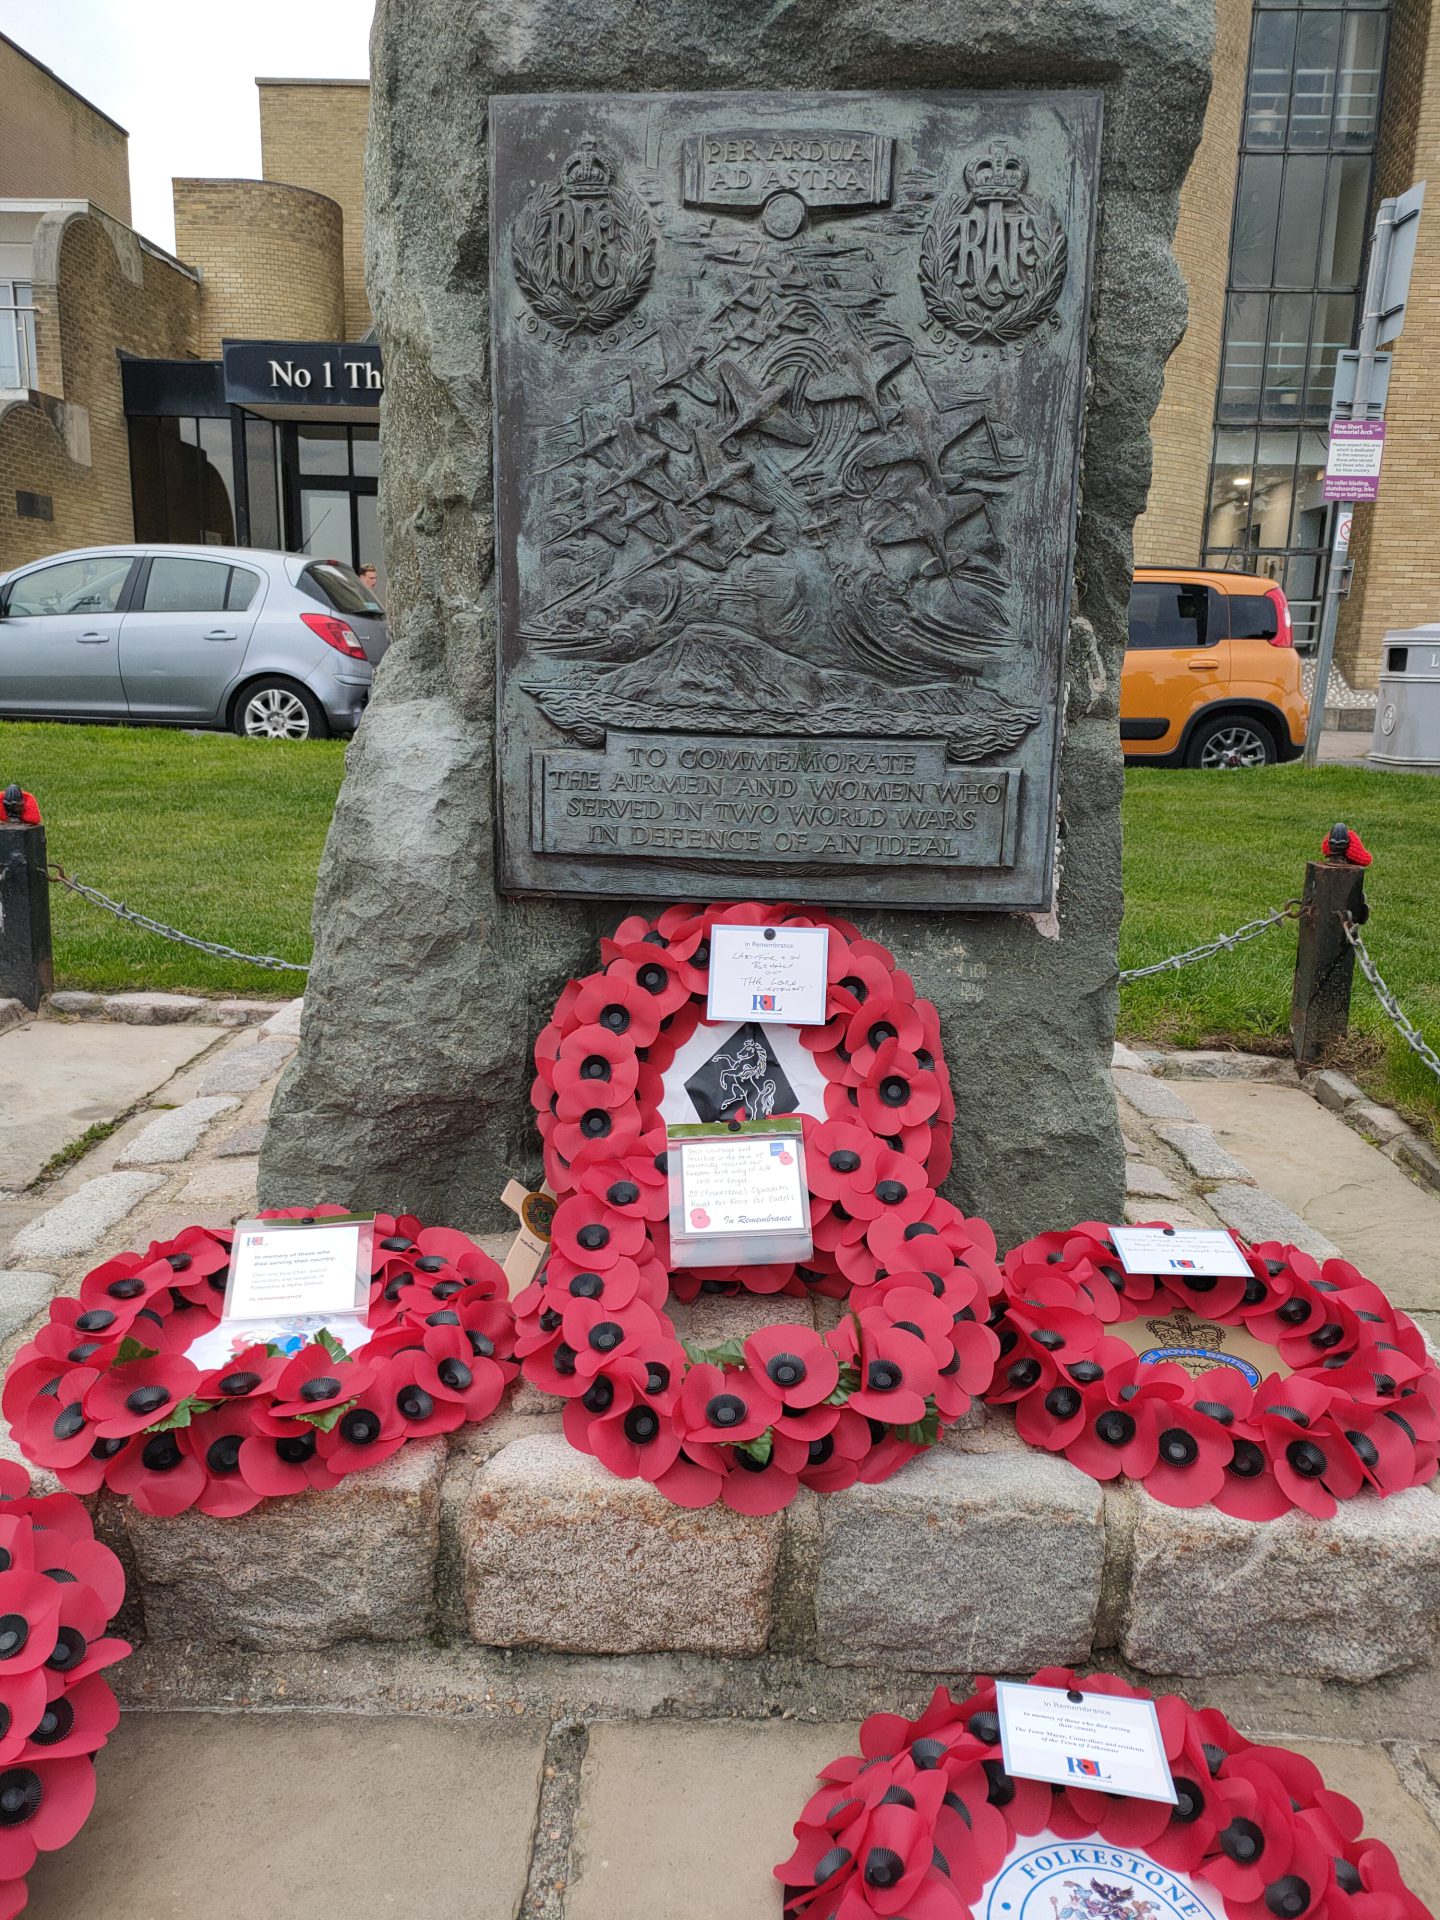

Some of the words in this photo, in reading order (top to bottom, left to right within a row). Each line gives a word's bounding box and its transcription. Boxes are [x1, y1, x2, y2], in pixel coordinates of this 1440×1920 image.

[706, 140, 761, 163] PER
[766, 140, 872, 162] ARDUA
[709, 169, 751, 191] AD
[760, 167, 868, 191] ASTRA
[953, 202, 1038, 306] RAF
[919, 315, 973, 362] 1939
[268, 360, 311, 387] No
[321, 361, 334, 388] 1
[625, 747, 667, 768] TO
[678, 749, 917, 775] COMMEMORATE
[549, 769, 600, 791] THE
[608, 772, 724, 796] AIRMEN
[732, 776, 799, 798] AND
[807, 778, 925, 803] WOMEN
[928, 782, 1002, 805] WHO
[566, 798, 664, 820] SERVED
[671, 801, 704, 821] IN
[707, 802, 779, 825] TWO
[787, 804, 888, 827] WORLD
[893, 808, 977, 830] WARS
[587, 824, 621, 844] IN
[630, 826, 761, 851] DEFENCE
[772, 831, 808, 851] OF
[818, 833, 865, 855] AN
[875, 835, 960, 858] IDEAL
[723, 1215, 734, 1224] In
[738, 1214, 793, 1224] Remembrance
[1159, 1348, 1203, 1357] ROYAL
[1205, 1349, 1257, 1377] BRITISH
[1054, 1701, 1111, 1716] Remembrance
[1020, 1848, 1202, 1918] FOLKESTONE
